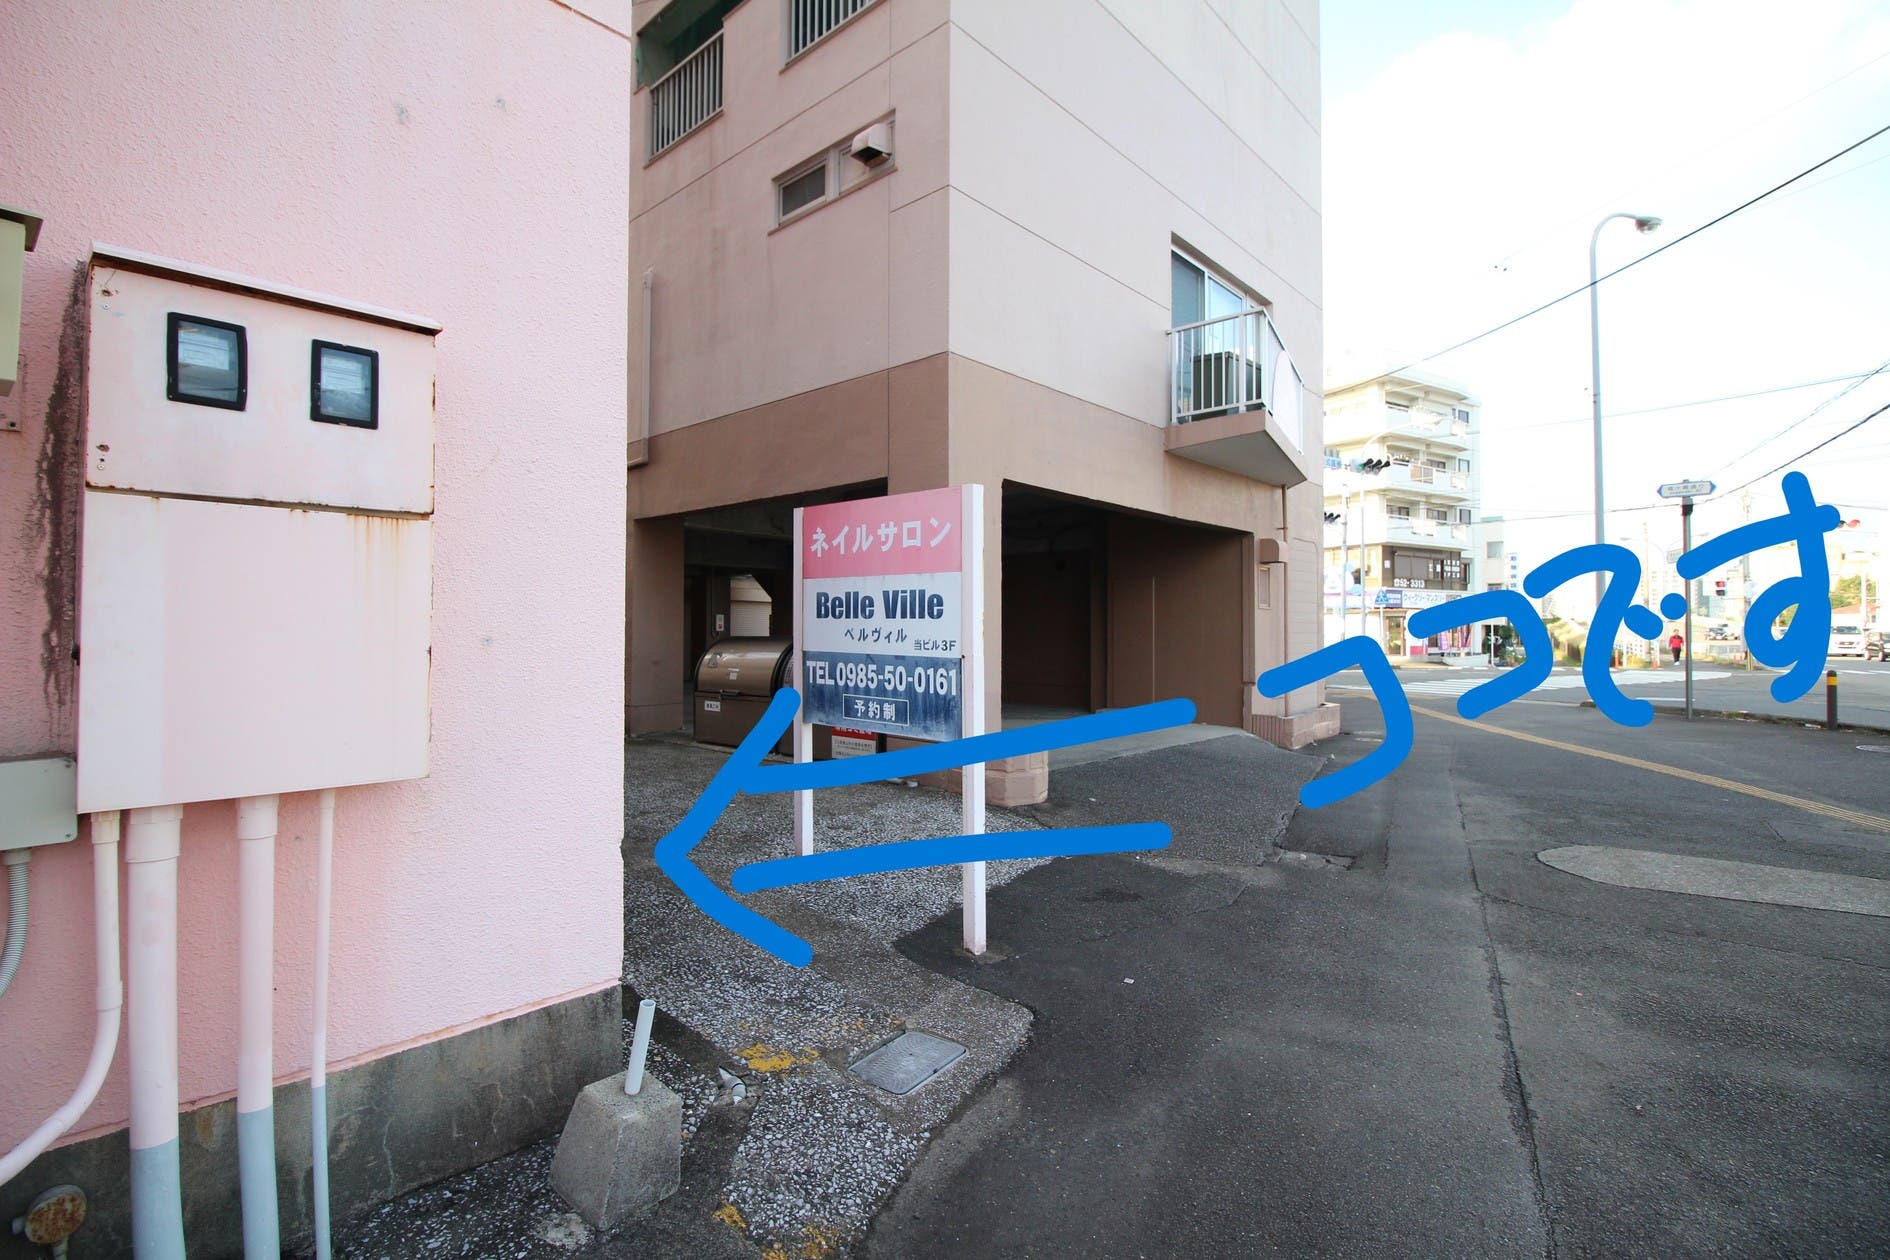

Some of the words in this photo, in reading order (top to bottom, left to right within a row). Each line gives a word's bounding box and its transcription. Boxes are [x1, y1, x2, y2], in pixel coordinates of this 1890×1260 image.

[810, 517, 951, 557] ネイルサロン
[816, 591, 875, 619] Belle
[882, 589, 944, 619] Ville
[844, 627, 907, 643] ベルヴィル
[854, 699, 896, 721] 予約制
